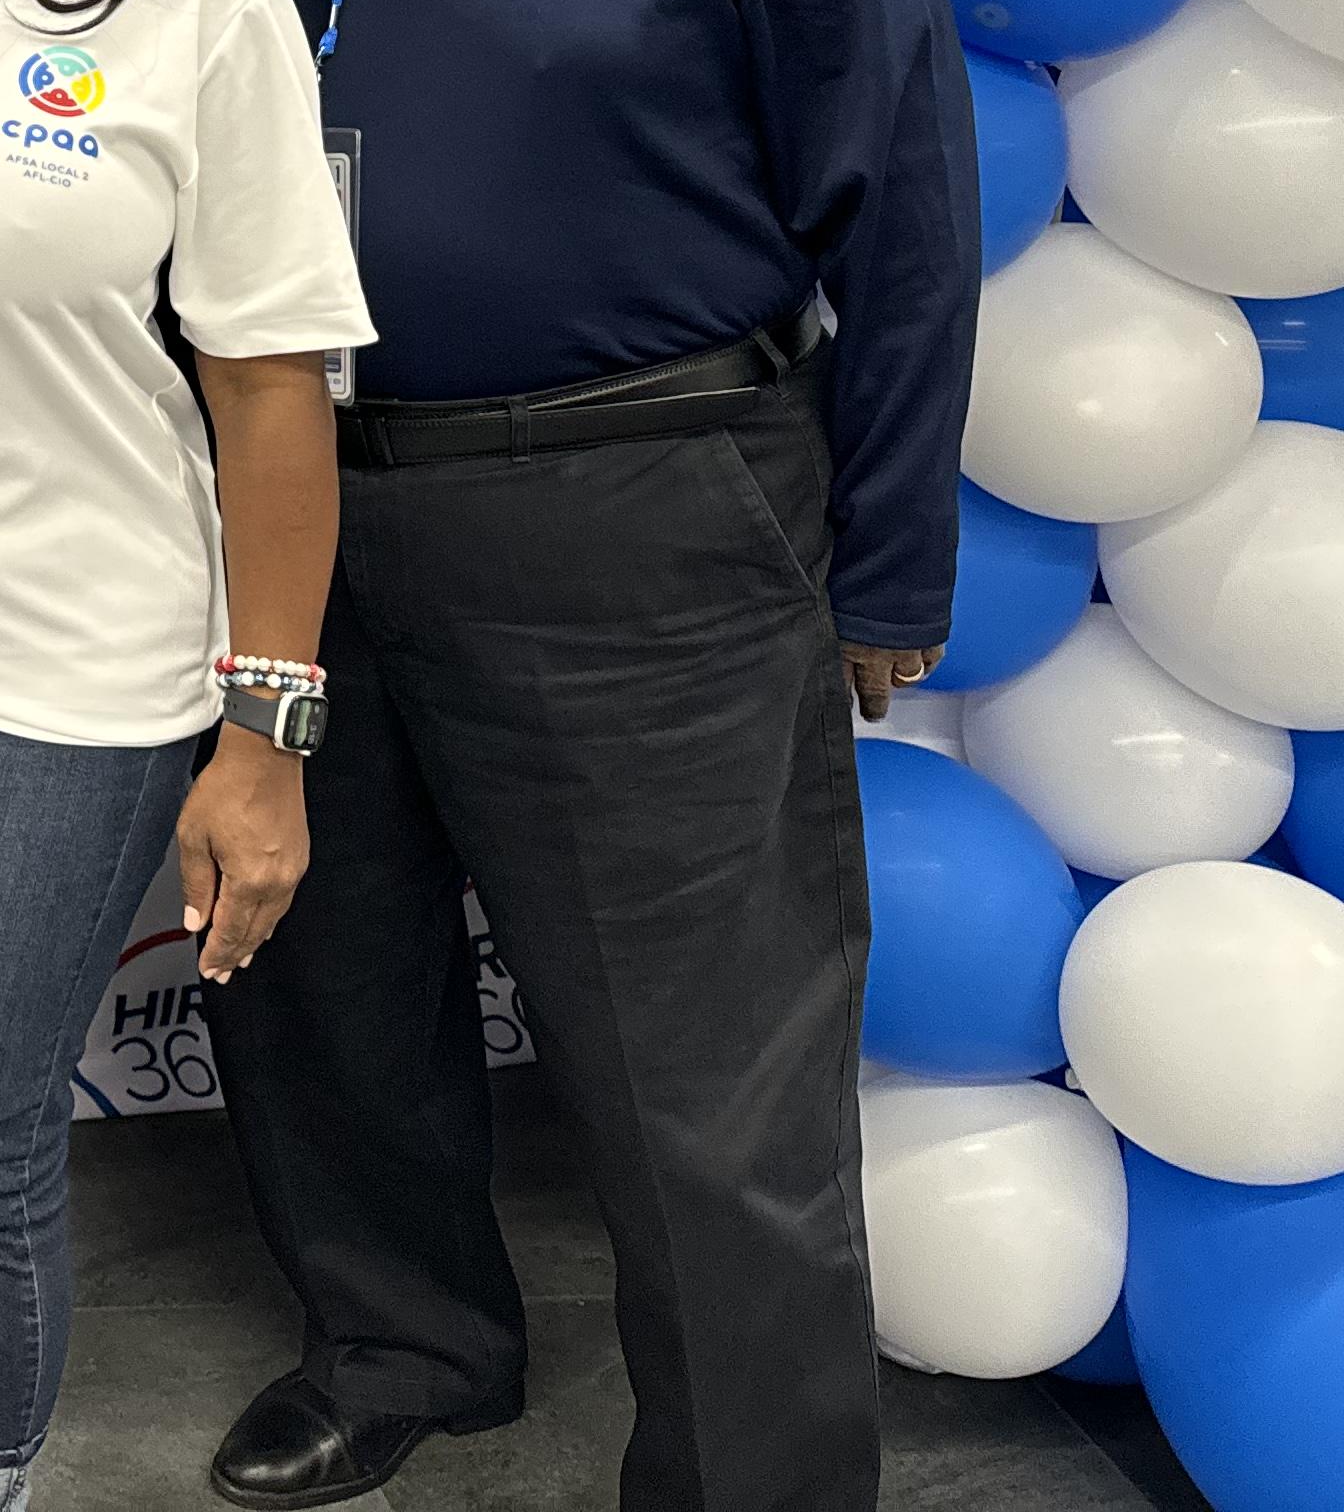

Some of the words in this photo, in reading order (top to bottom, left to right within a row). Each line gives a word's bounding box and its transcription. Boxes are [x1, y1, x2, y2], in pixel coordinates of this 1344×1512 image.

[1, 120, 100, 159] cpaa
[6, 154, 38, 168] AFSA
[41, 161, 80, 179] LOCAL
[82, 171, 90, 181] 2
[23, 169, 72, 188] AFL-CIO
[112, 984, 204, 1035] HIR
[111, 1029, 217, 1102] 36
